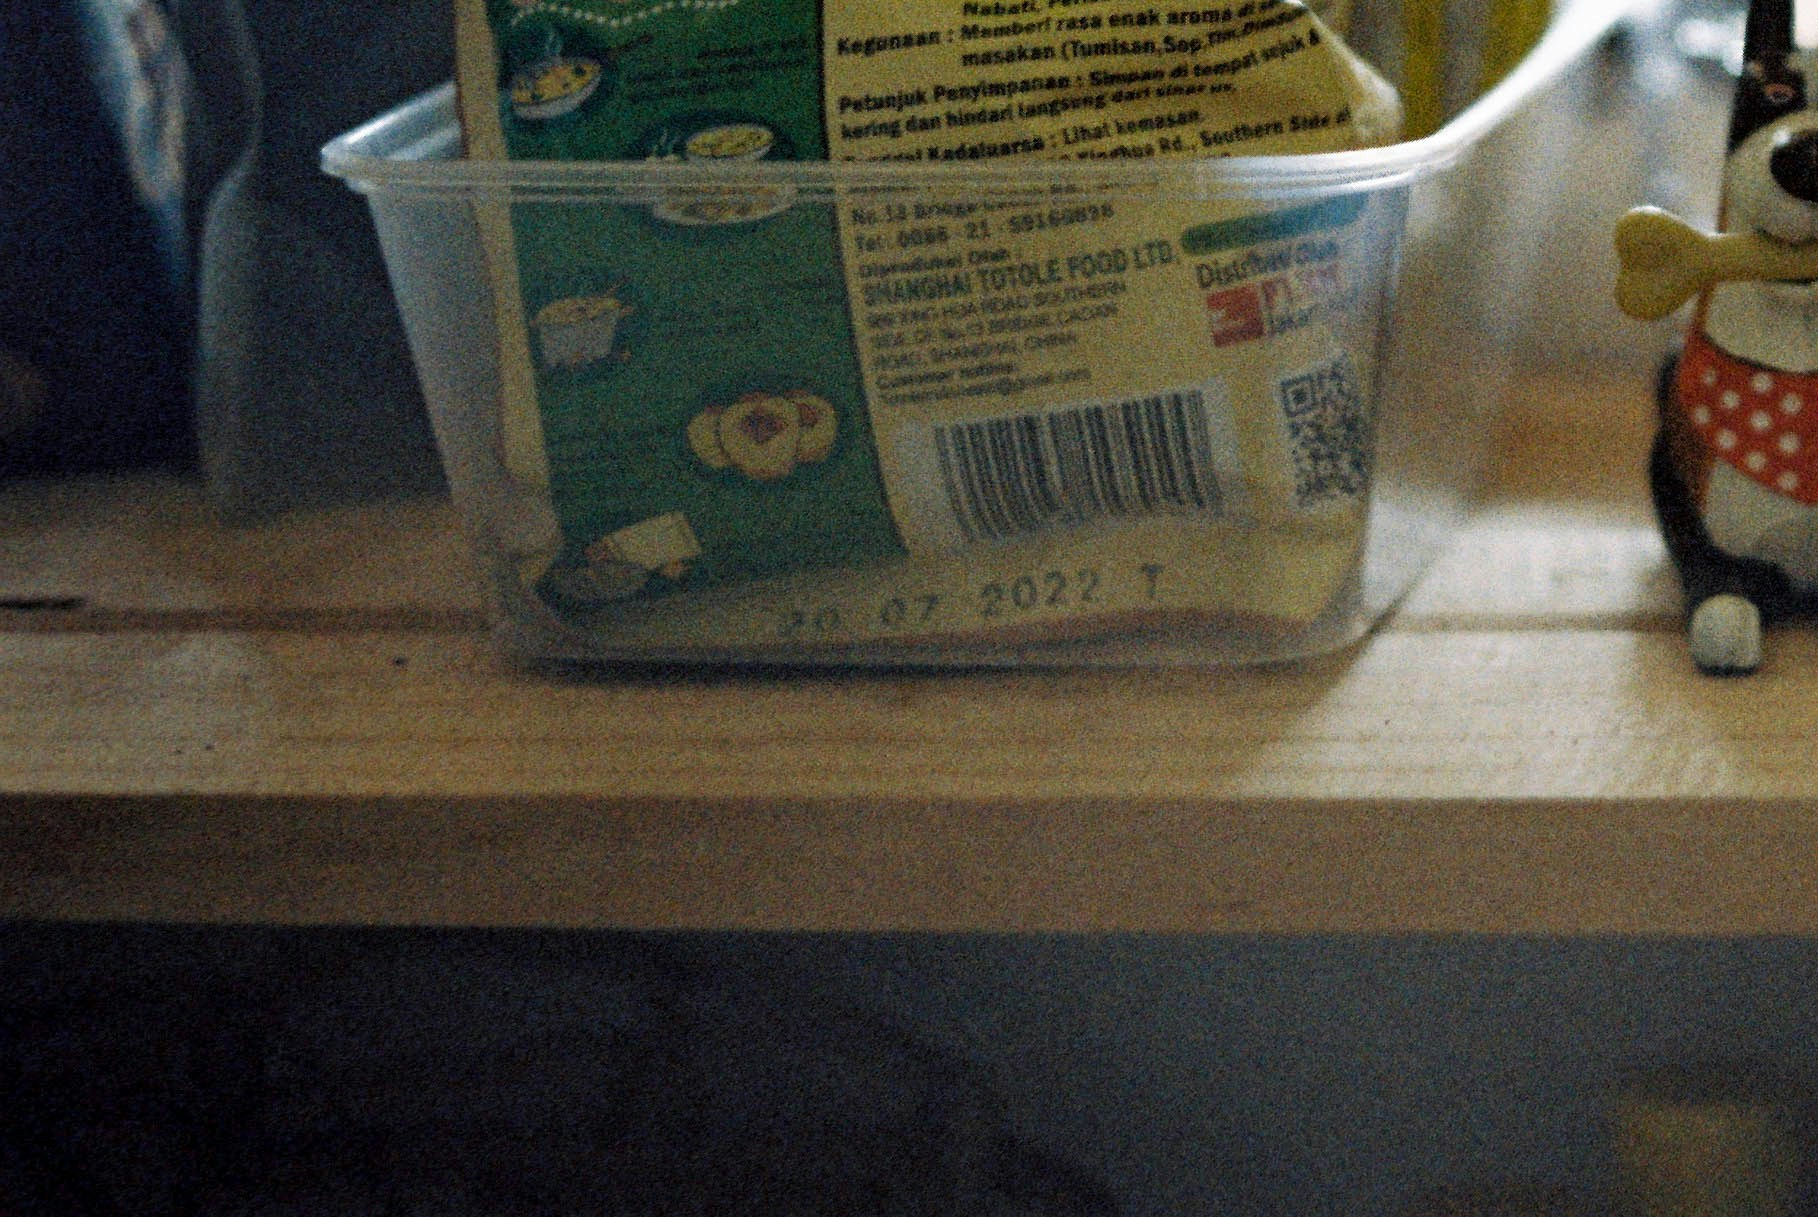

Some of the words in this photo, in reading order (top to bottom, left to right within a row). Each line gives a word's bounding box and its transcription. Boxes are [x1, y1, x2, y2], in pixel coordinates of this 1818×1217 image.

[837, 31, 941, 57] Kegunaan
[960, 17, 1052, 41] Memberi
[1056, 10, 1102, 31] rasa
[1108, 7, 1161, 28] enak
[1166, 3, 1233, 26] aroma
[961, 44, 1057, 69] masakan
[838, 88, 927, 114] Petunjuk
[932, 76, 1071, 102] Penyimpanan
[1089, 68, 1165, 87] Simpan
[1170, 64, 1189, 80] di
[841, 120, 901, 140] kering
[905, 114, 942, 133] dan
[945, 107, 1013, 126] hindari
[1017, 92, 1107, 117] langsung
[1111, 86, 1151, 103] dari
[926, 136, 1045, 161] Kadaluarsa
[1062, 124, 1111, 146] Lihat
[1199, 119, 1285, 148] Southern
[1289, 111, 1331, 133] Side
[862, 274, 973, 307] SHANGHAI
[978, 259, 1063, 291] TOTOLE
[1067, 247, 1129, 279] FOOD
[878, 594, 939, 626] 07
[979, 568, 1101, 618] 2022
[1139, 562, 1164, 599] T
